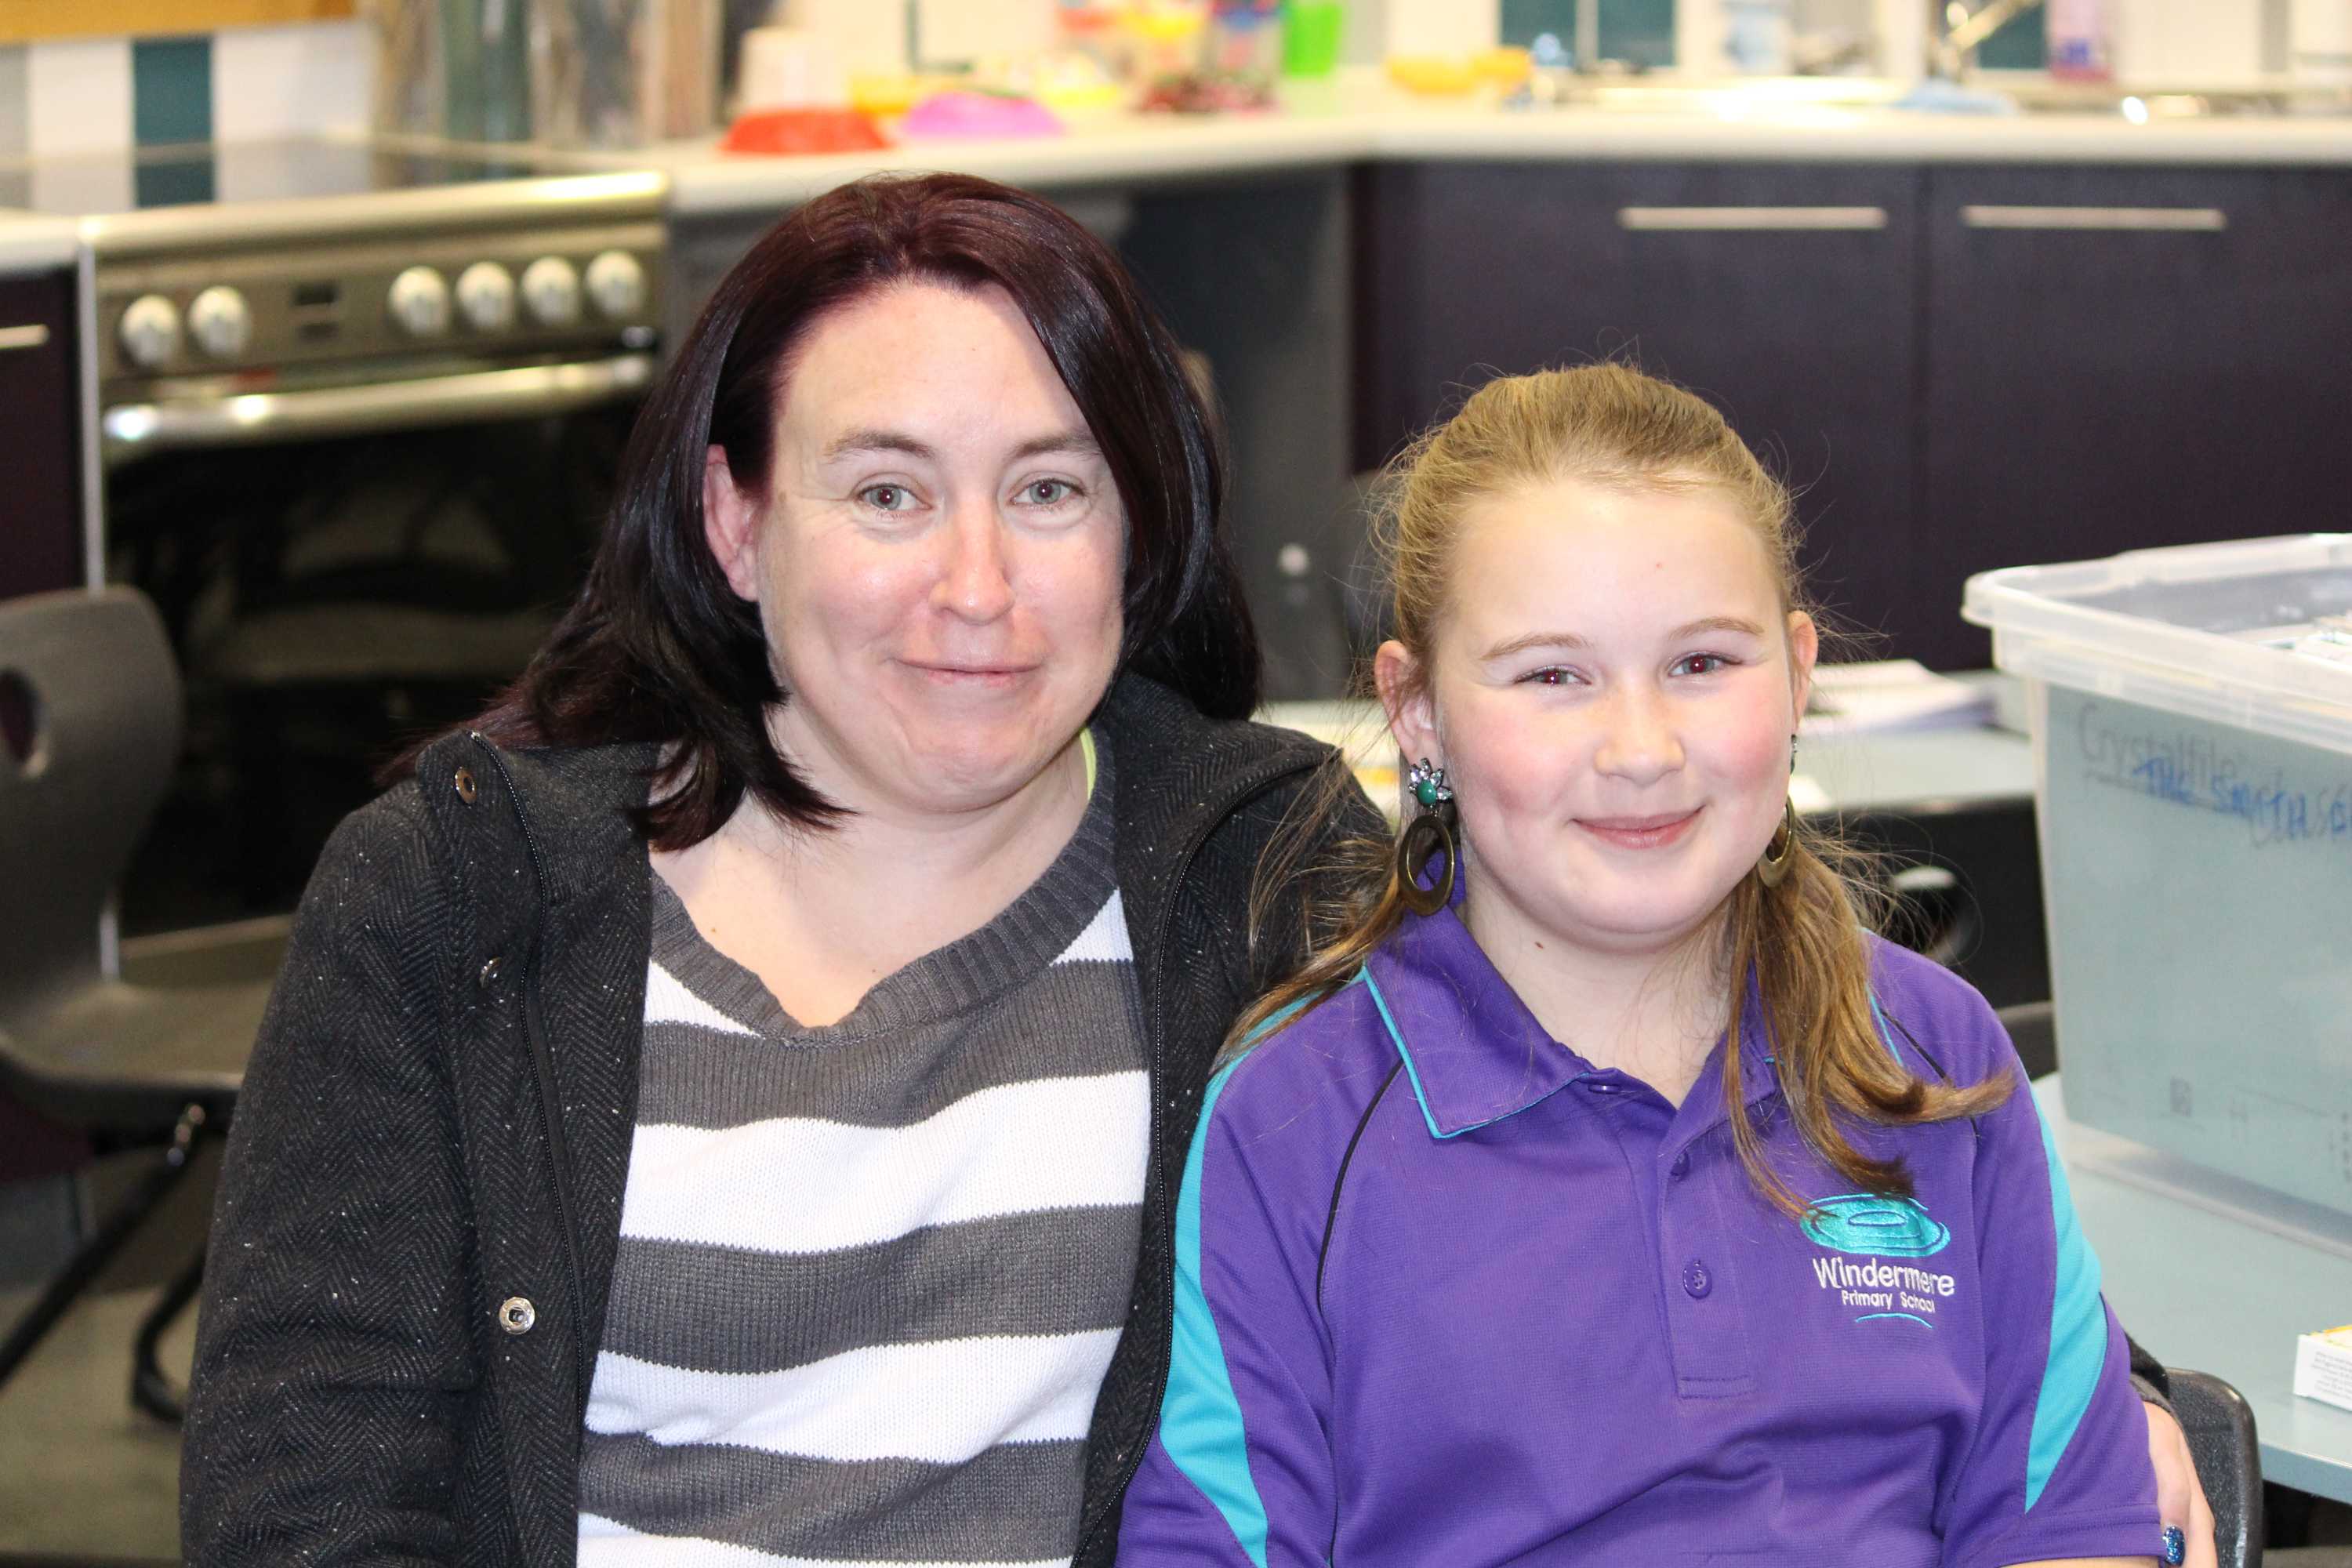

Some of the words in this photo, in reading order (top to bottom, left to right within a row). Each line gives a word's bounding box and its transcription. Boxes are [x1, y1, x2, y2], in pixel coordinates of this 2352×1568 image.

[1812, 1256, 1955, 1297] Windermere
[1841, 1290, 1893, 1310] Primary
[1900, 1291, 1936, 1313] School
